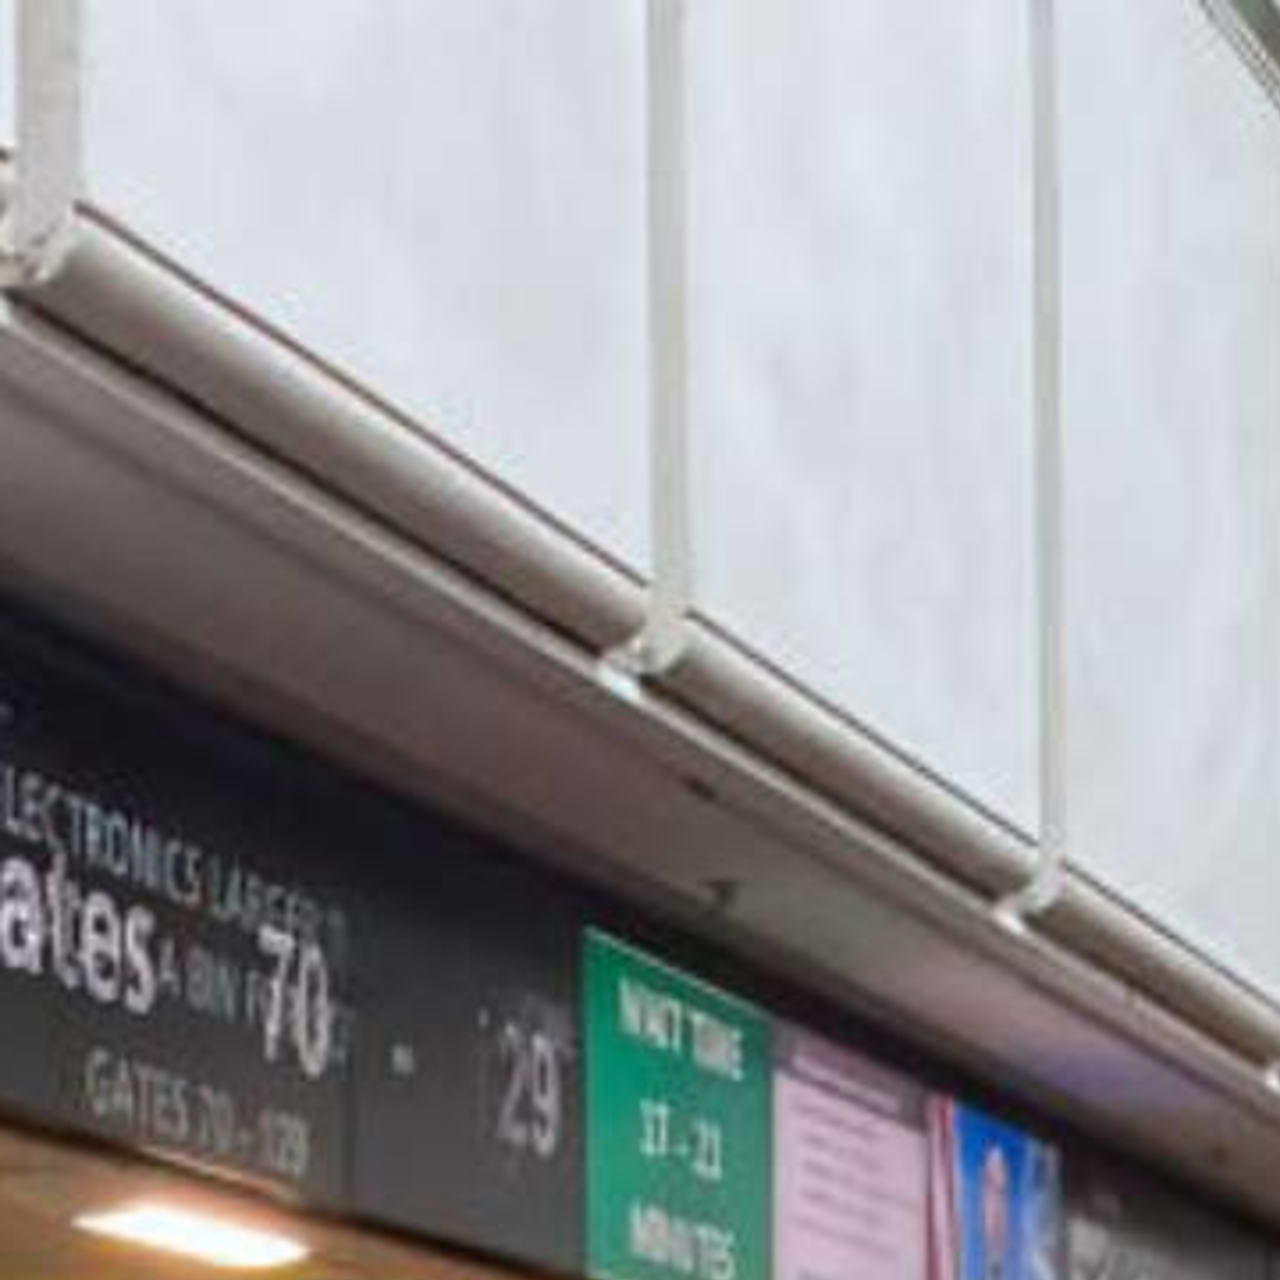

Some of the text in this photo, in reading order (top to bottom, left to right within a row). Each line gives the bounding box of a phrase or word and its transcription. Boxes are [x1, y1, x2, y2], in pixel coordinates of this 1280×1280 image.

[0, 853, 155, 1015] ates
[258, 923, 330, 1080] 70
[83, 1044, 190, 1138] GATES
